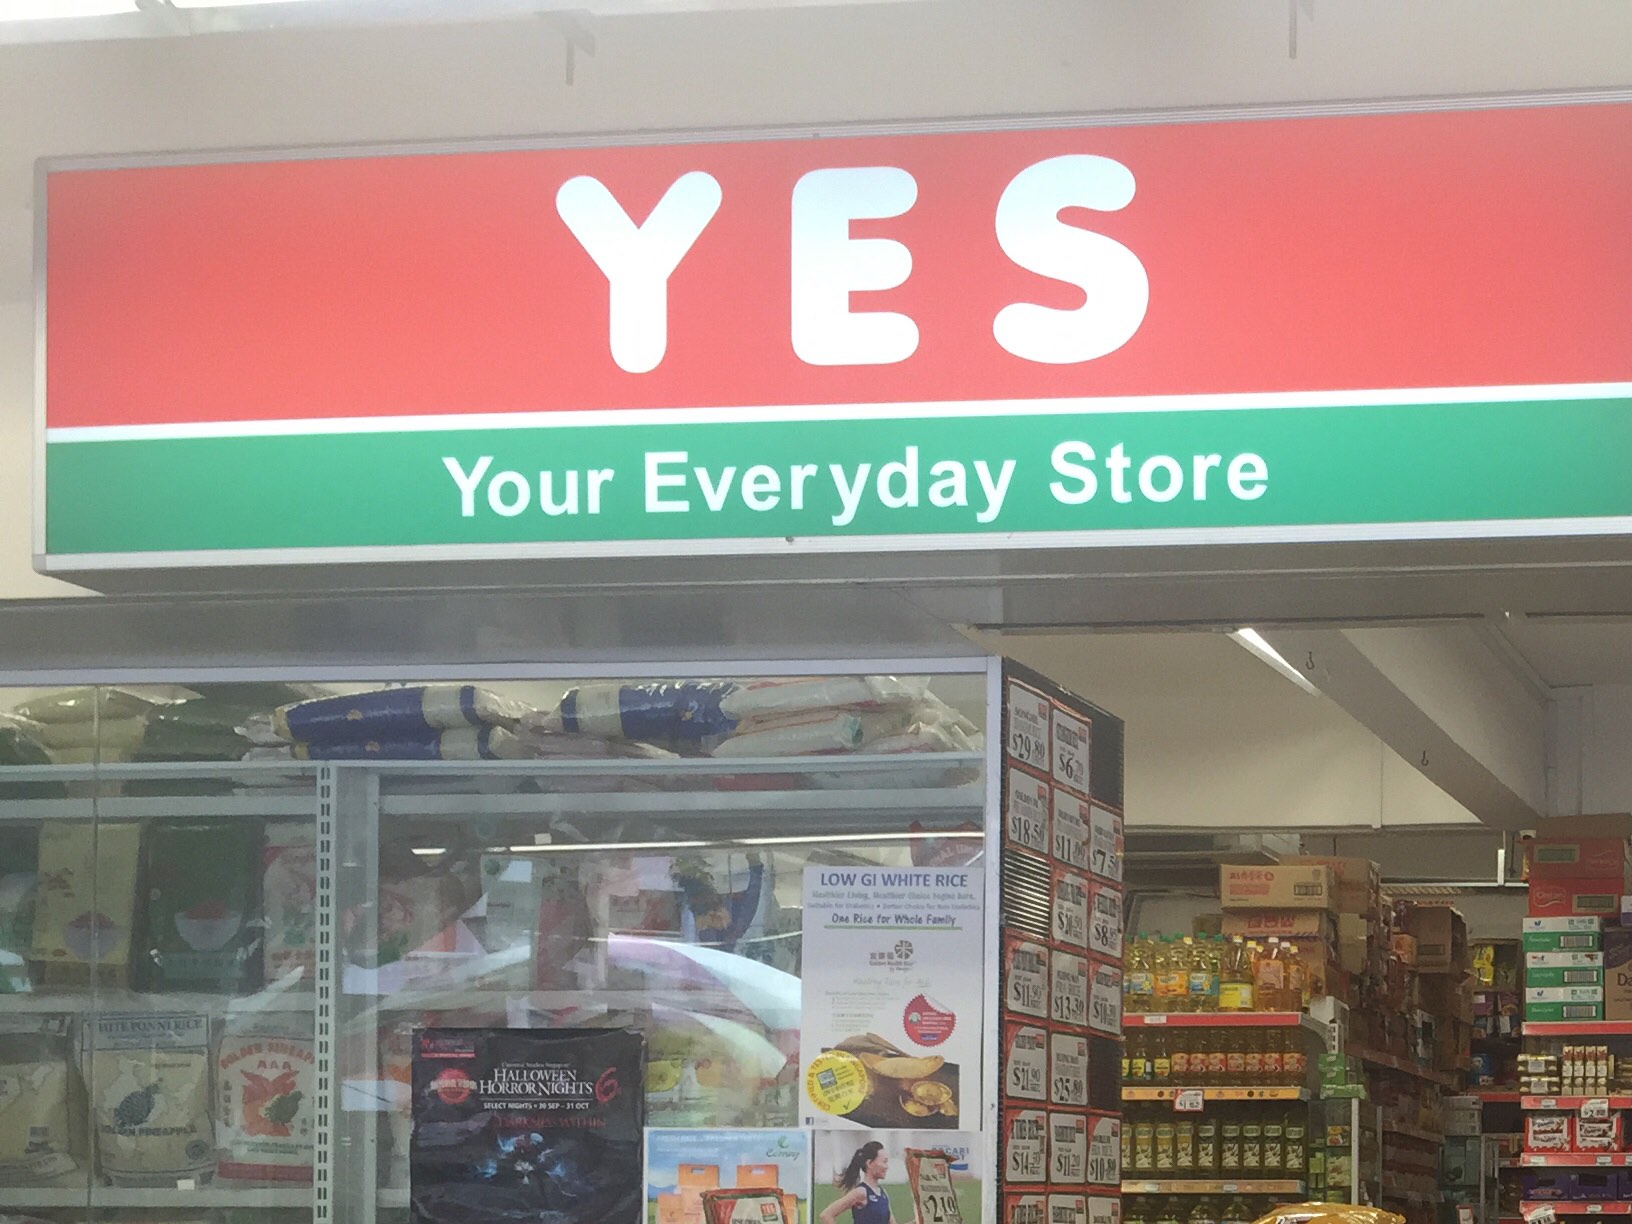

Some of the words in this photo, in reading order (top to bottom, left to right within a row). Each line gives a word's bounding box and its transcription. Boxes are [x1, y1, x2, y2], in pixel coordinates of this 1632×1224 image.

[556, 153, 1150, 374] YES
[442, 456, 614, 517] Your
[644, 446, 1016, 526] Everyday
[1050, 440, 1269, 506] Store
[821, 873, 856, 887] LOW
[861, 874, 876, 886] GI
[882, 874, 930, 887] WHITE
[936, 874, 968, 887] RICE
[832, 913, 849, 923] One
[854, 914, 873, 923] Rice
[877, 914, 890, 924] for
[895, 914, 922, 924] Whole
[927, 914, 956, 926] Family
[494, 1069, 576, 1081] HALLOWEEN
